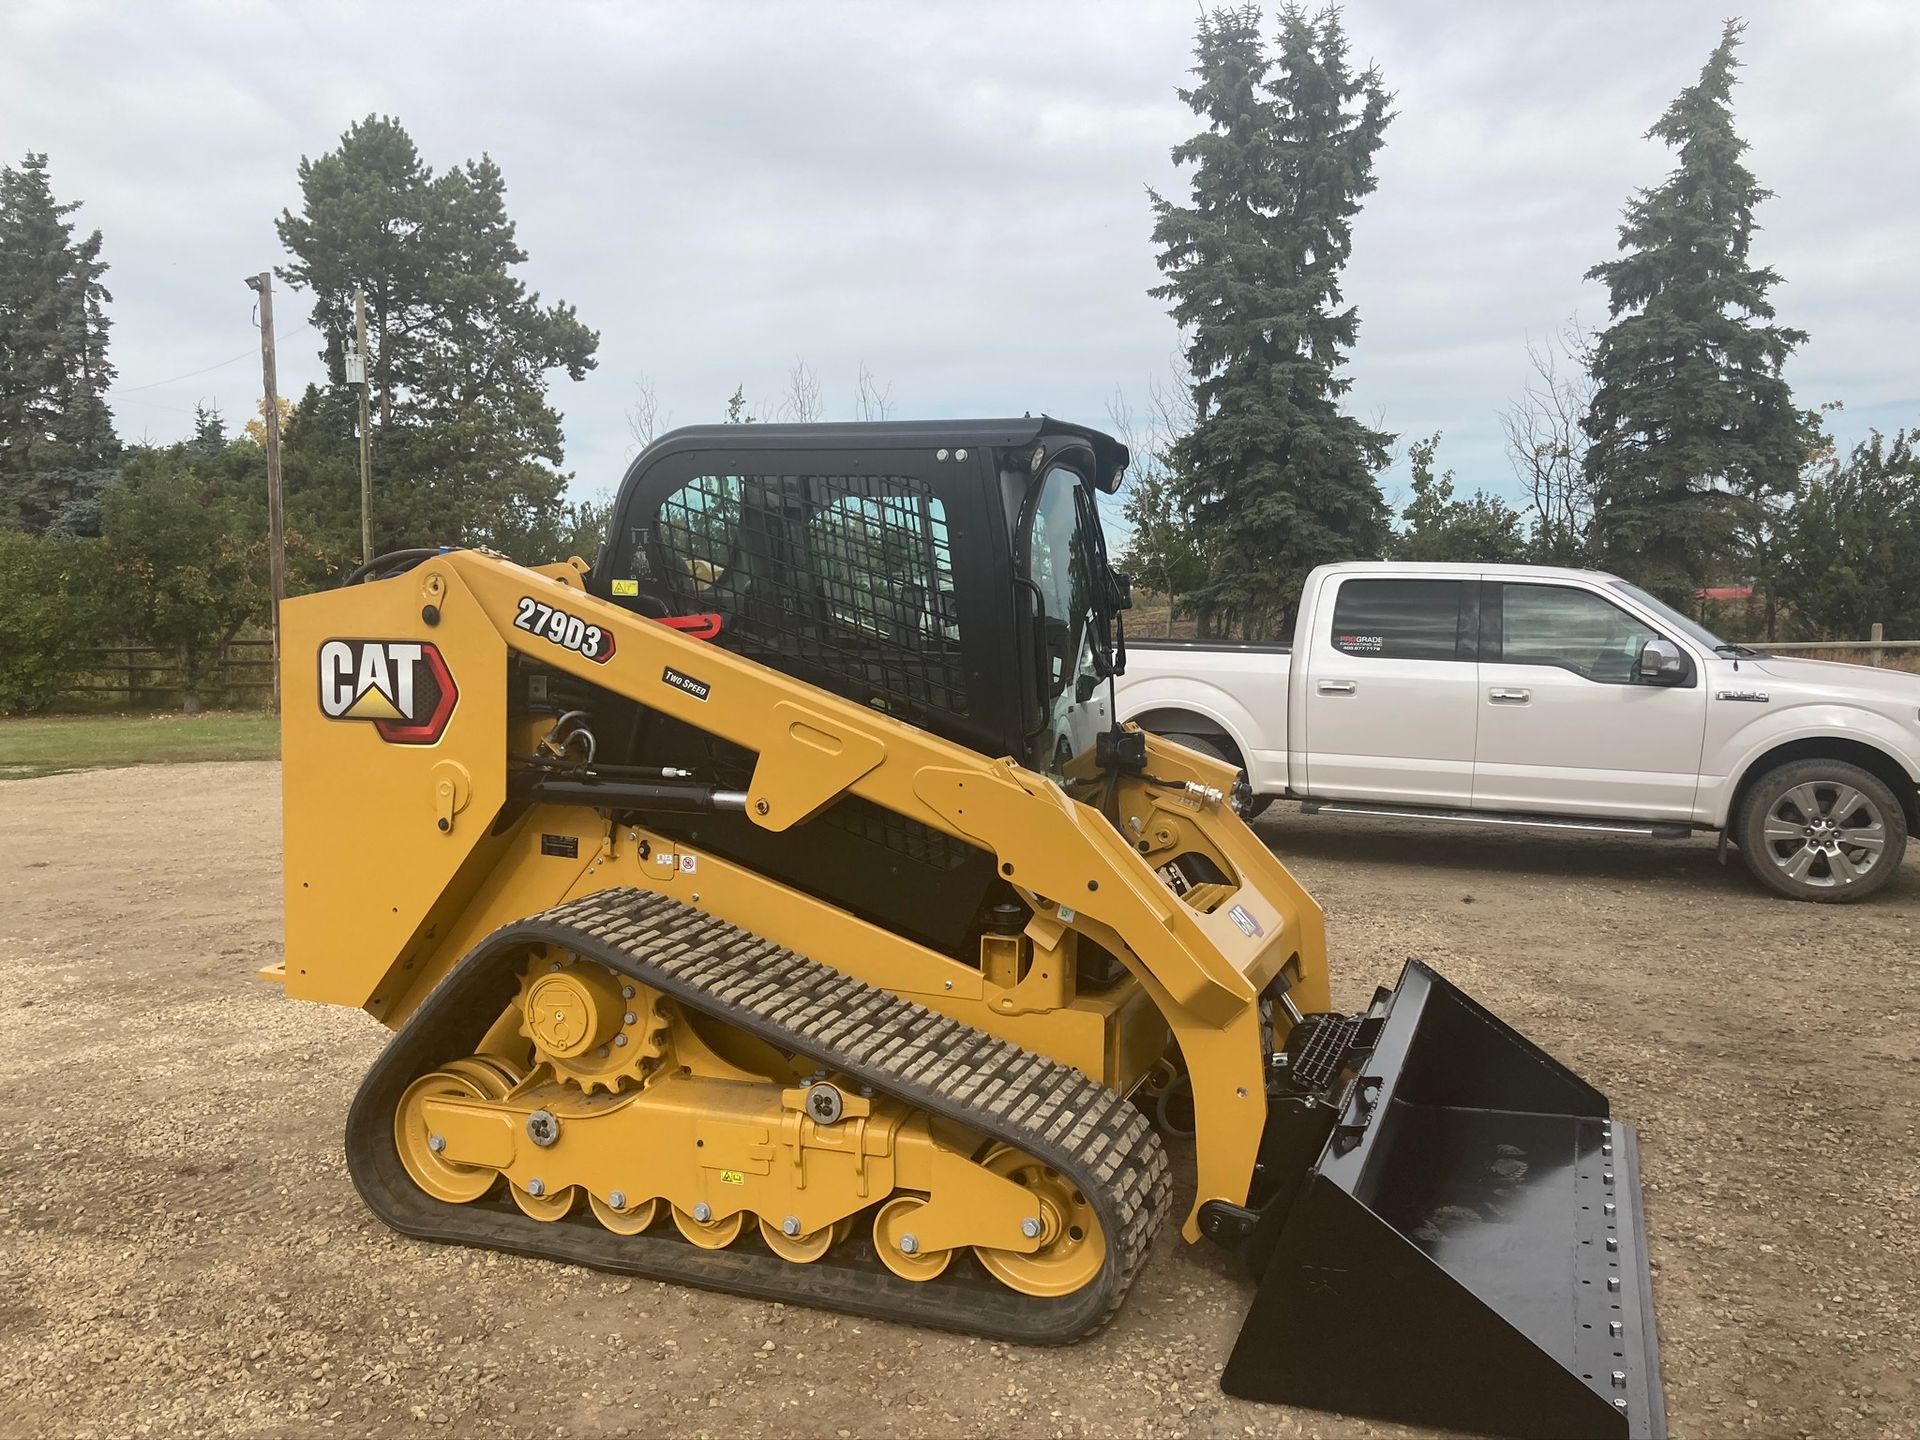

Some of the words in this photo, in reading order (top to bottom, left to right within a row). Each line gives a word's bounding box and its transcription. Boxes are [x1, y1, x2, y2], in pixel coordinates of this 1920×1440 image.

[515, 597, 602, 658] 279D3
[320, 641, 422, 719] CAT
[1229, 905, 1257, 937] CAT
